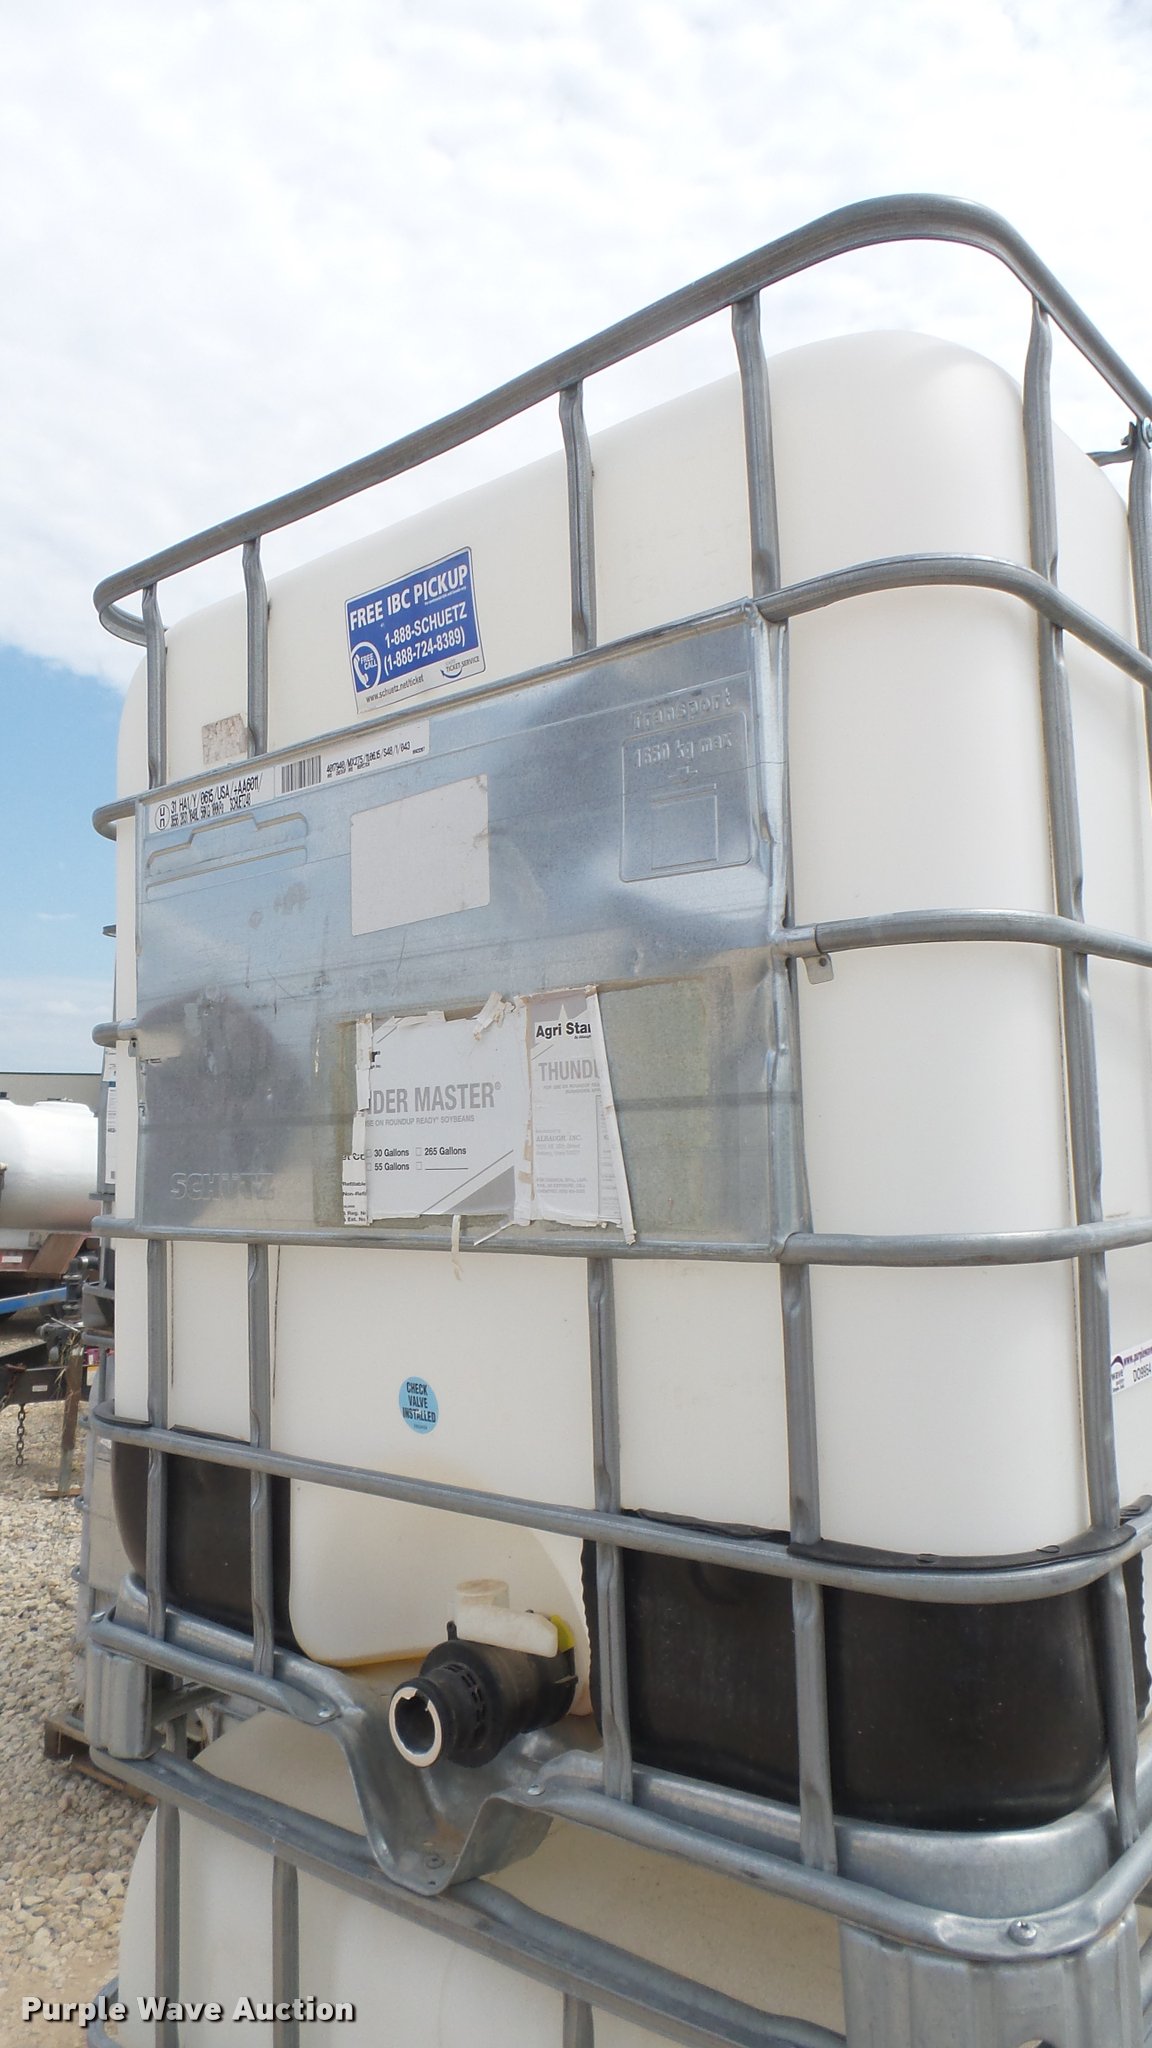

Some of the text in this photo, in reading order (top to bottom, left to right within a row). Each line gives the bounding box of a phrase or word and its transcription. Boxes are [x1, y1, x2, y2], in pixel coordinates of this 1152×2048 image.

[350, 600, 383, 631] FREE
[387, 588, 411, 615] IBC
[414, 565, 468, 604] PICKUP
[385, 602, 467, 648] 1-888-SCHUETZ
[384, 626, 465, 676] (1-888-724-8389)
[360, 652, 374, 664] FREE
[364, 660, 377, 671] CALL
[365, 674, 424, 703] www.schuetz.net/ticket
[536, 1023, 561, 1039] Agri
[375, 1118, 384, 1126] ON
[385, 1117, 415, 1126] ROUNDUP
[374, 1148, 383, 1157] 30
[384, 1148, 410, 1157] Gallons
[424, 1146, 467, 1156] 265 Gallons
[374, 1162, 410, 1171] 55 Gallons
[406, 1382, 428, 1396] CHECK
[407, 1395, 428, 1408] VALVE
[402, 1407, 436, 1423] INSTALLED
